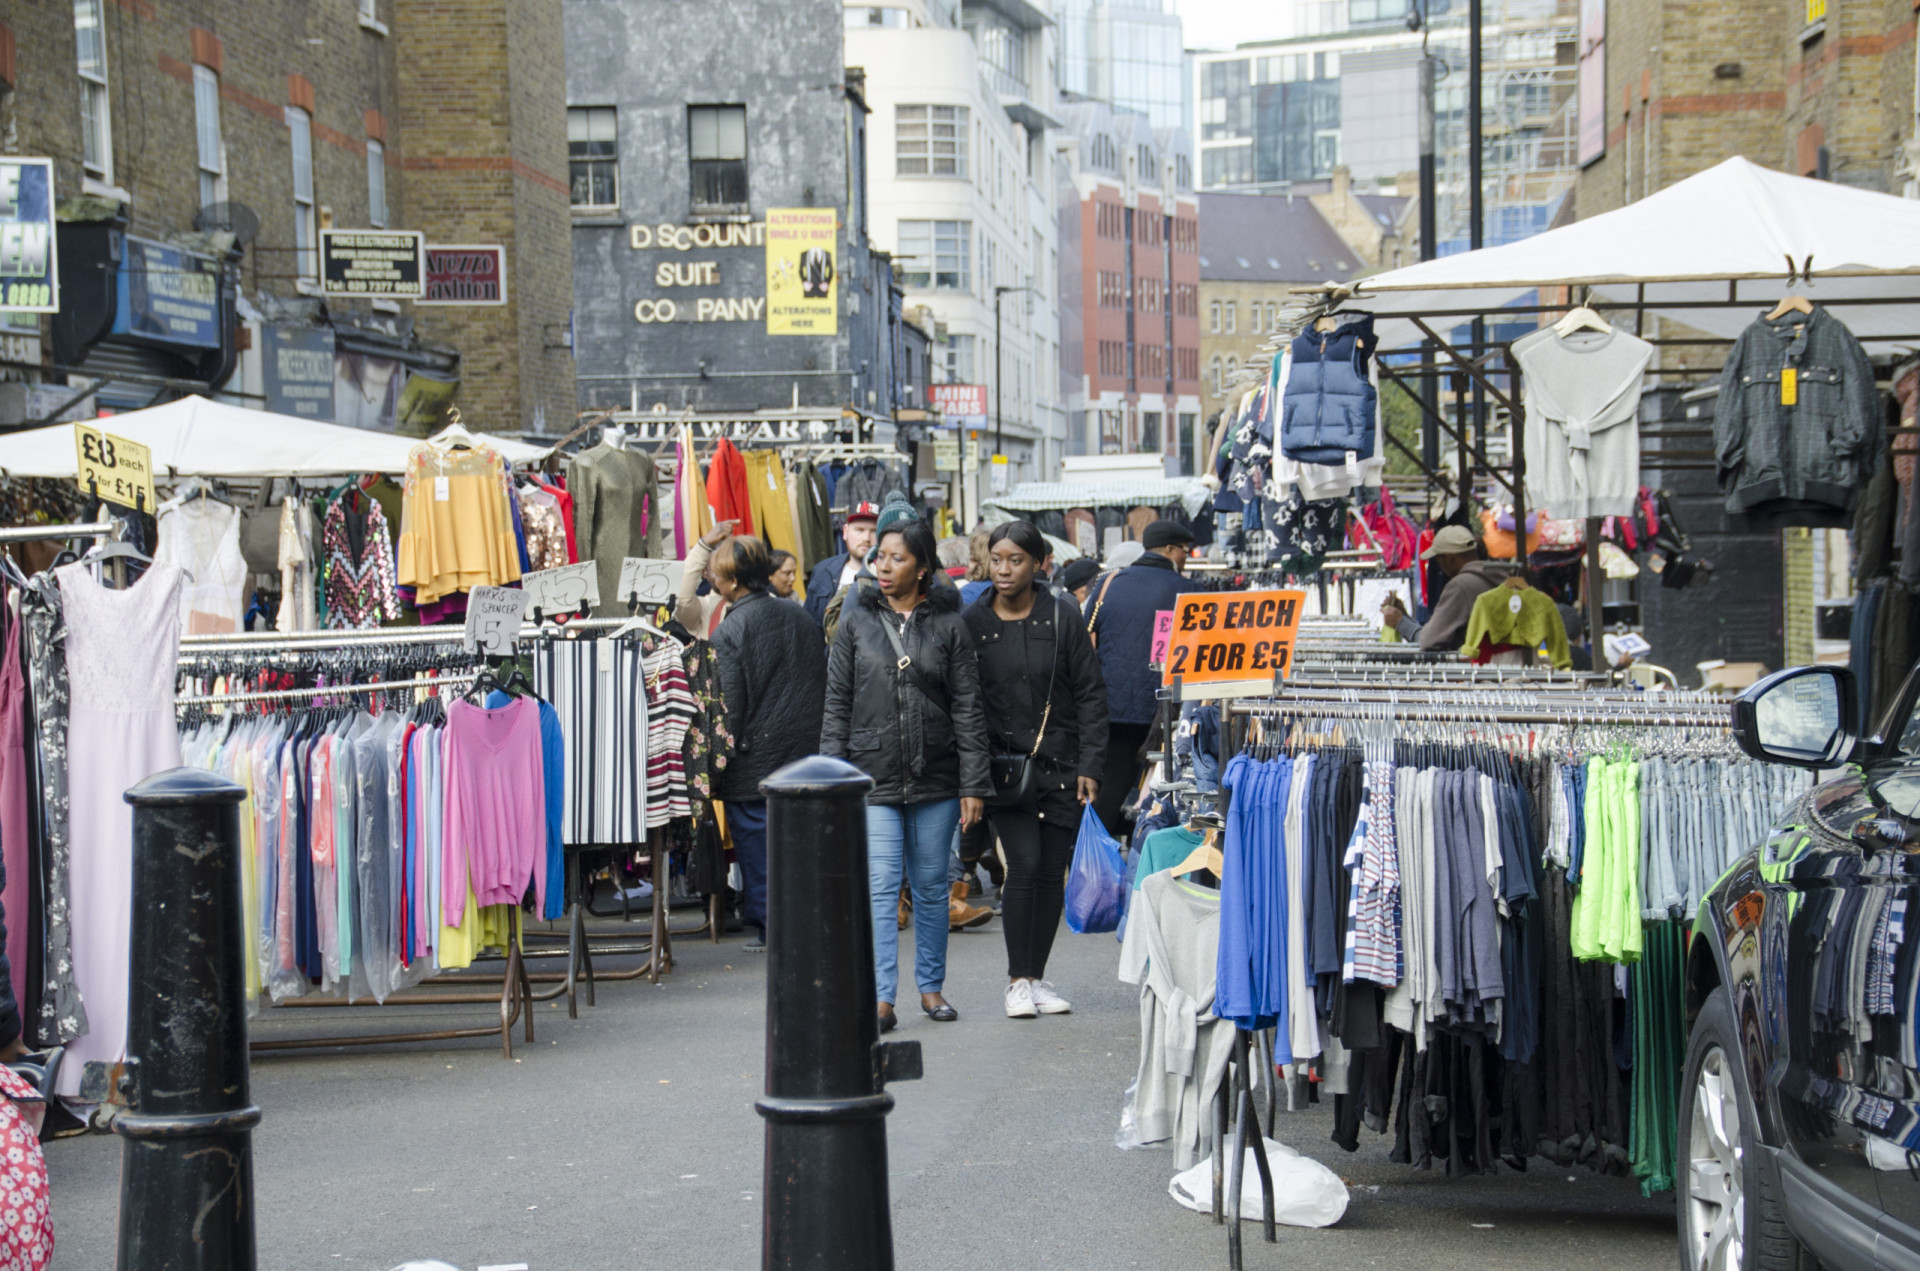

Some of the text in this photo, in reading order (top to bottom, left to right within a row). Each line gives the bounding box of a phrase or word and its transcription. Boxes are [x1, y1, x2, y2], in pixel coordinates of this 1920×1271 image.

[770, 214, 832, 224] ALTERATIONS
[770, 230, 833, 239] WHILE U WAIT
[656, 262, 717, 287] SUIT
[427, 276, 497, 299] ashion
[772, 306, 832, 315] ALTERATIONS
[791, 319, 814, 328] HERE
[935, 386, 979, 400] MINI
[701, 420, 801, 438] WEAR
[82, 433, 117, 469] £8
[119, 457, 144, 472] each
[86, 468, 146, 501] 2 for £15
[476, 590, 506, 602] MARKS
[482, 602, 518, 615] SPENCER
[1180, 599, 1296, 631] £3 EACH
[468, 613, 501, 650] £5
[1170, 641, 1289, 674] 2 FOR £5
